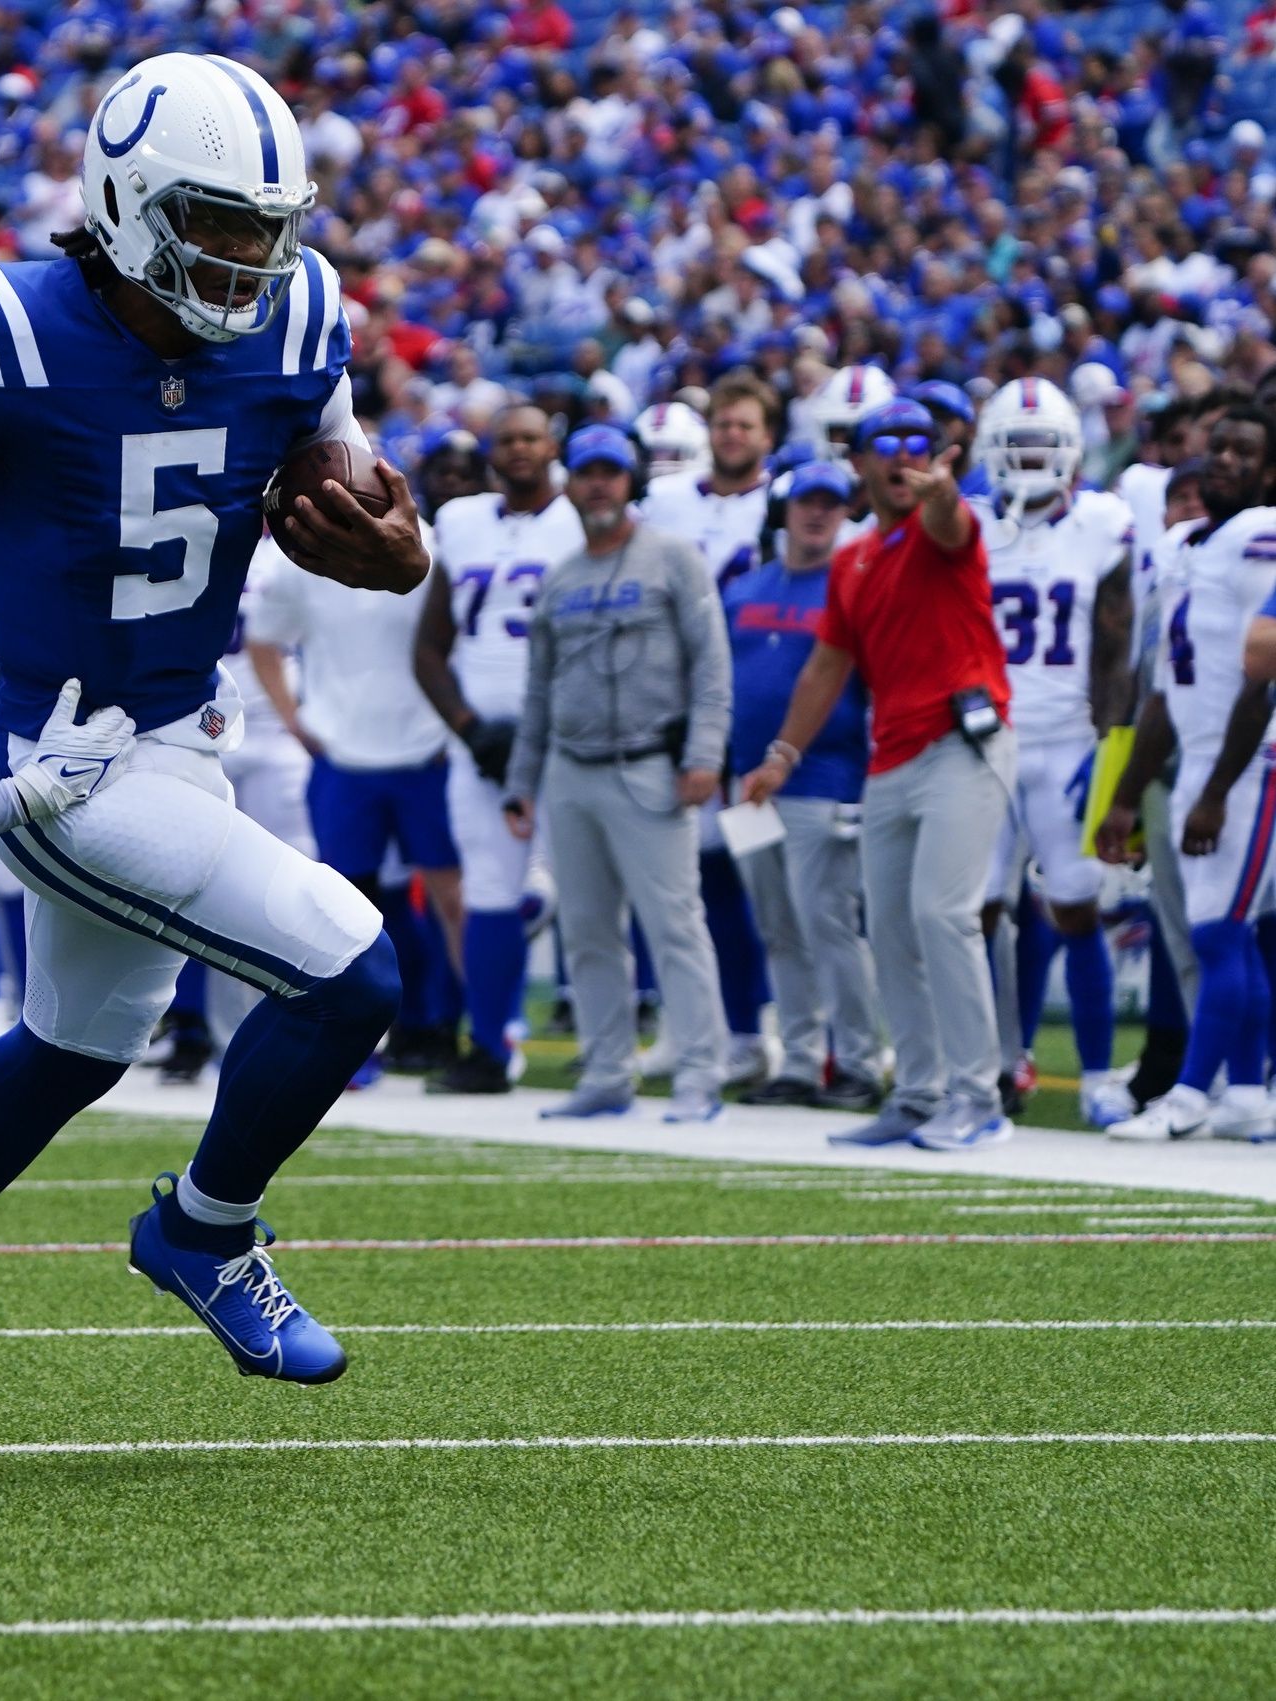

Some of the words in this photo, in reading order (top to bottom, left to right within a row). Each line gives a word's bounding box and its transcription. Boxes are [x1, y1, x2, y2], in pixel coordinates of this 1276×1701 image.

[263, 187, 282, 195] COLTS
[111, 427, 227, 620] 5
[991, 580, 1076, 665] 31
